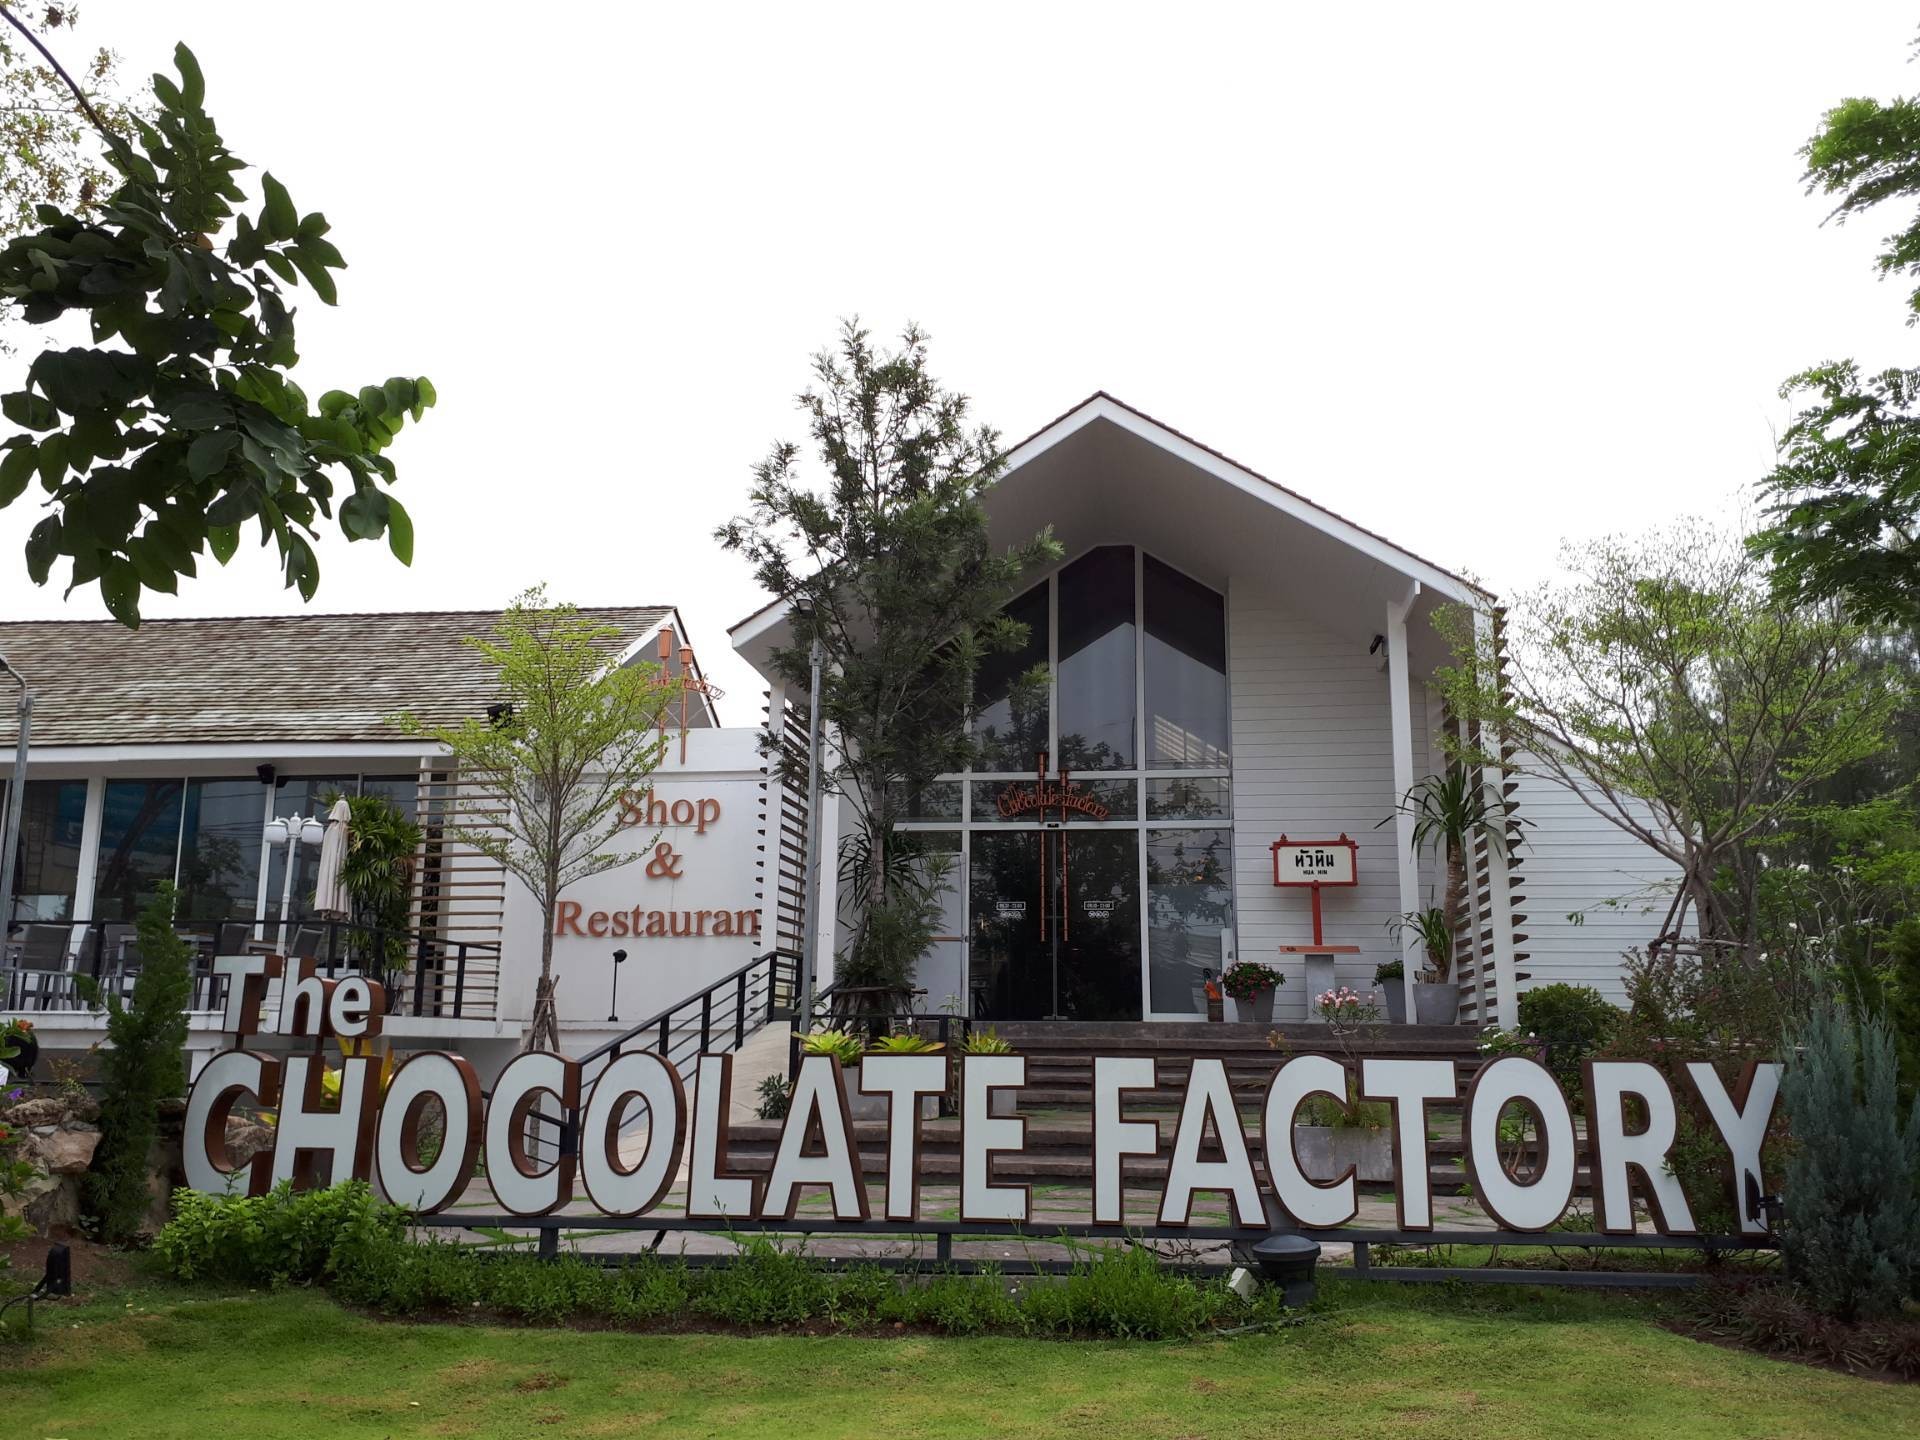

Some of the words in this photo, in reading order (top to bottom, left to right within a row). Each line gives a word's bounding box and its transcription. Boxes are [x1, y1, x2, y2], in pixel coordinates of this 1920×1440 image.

[618, 789, 721, 835] Shop
[645, 842, 684, 879] &
[213, 954, 385, 1038] The
[182, 1049, 1031, 1224] CHOCOLATE
[1092, 1053, 1786, 1236] FACTORY
